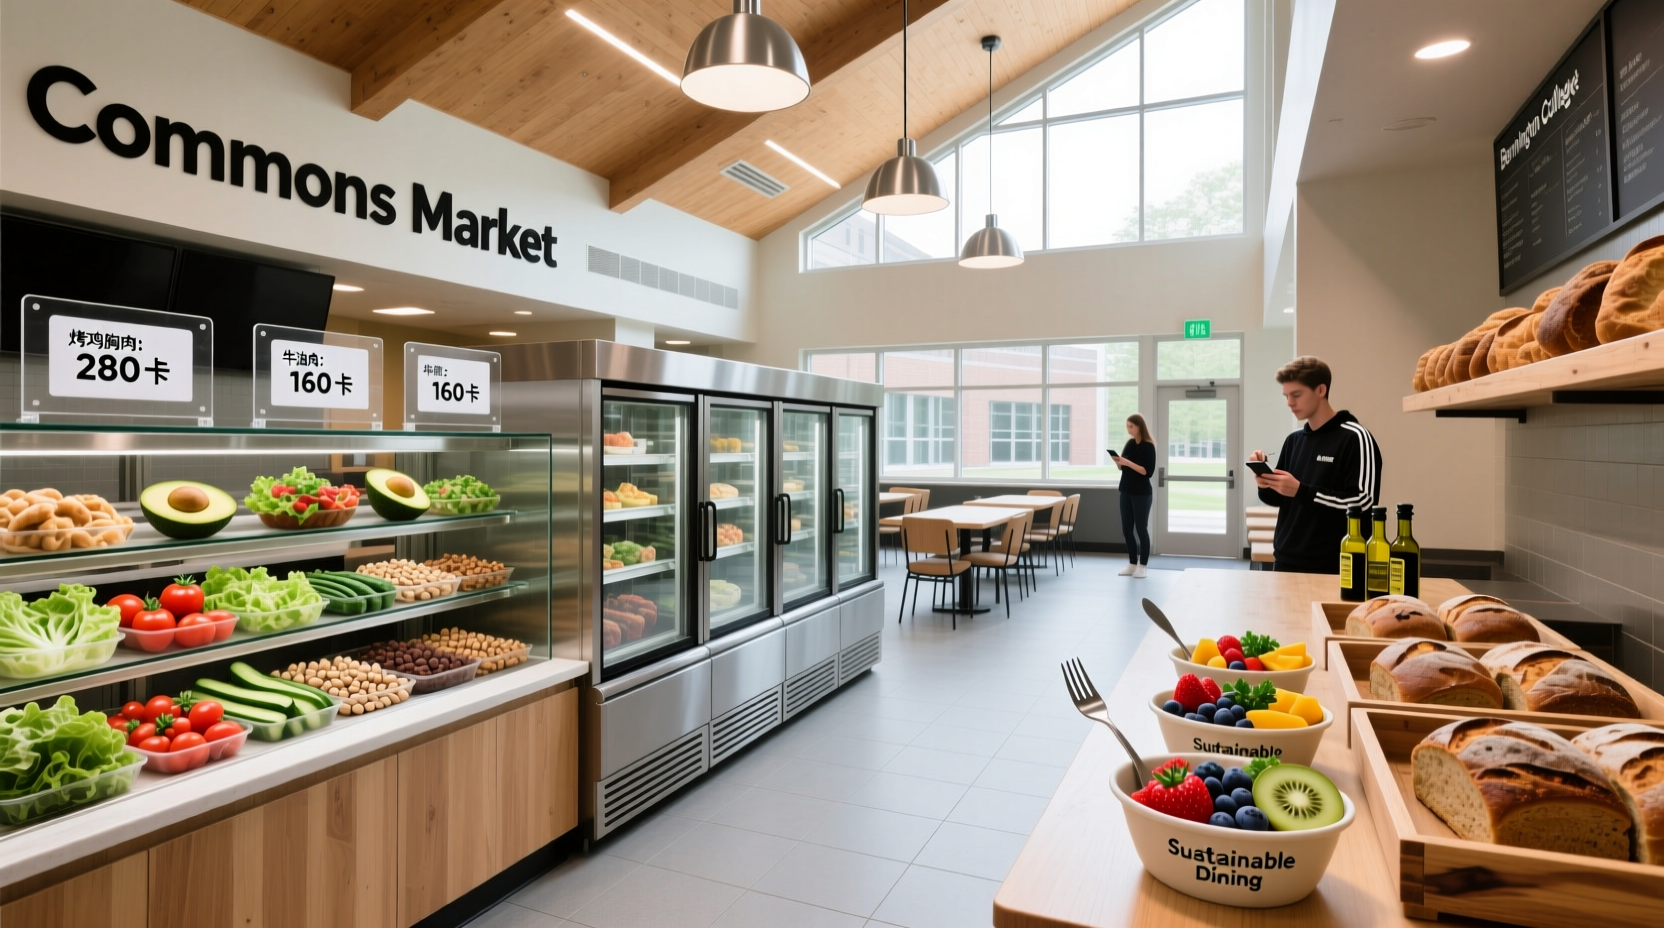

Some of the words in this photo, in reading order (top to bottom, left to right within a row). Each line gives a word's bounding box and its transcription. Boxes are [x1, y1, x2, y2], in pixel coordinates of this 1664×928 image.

[27, 65, 397, 226] Commons
[412, 182, 558, 268] Market
[1196, 865, 1263, 892] Dining
